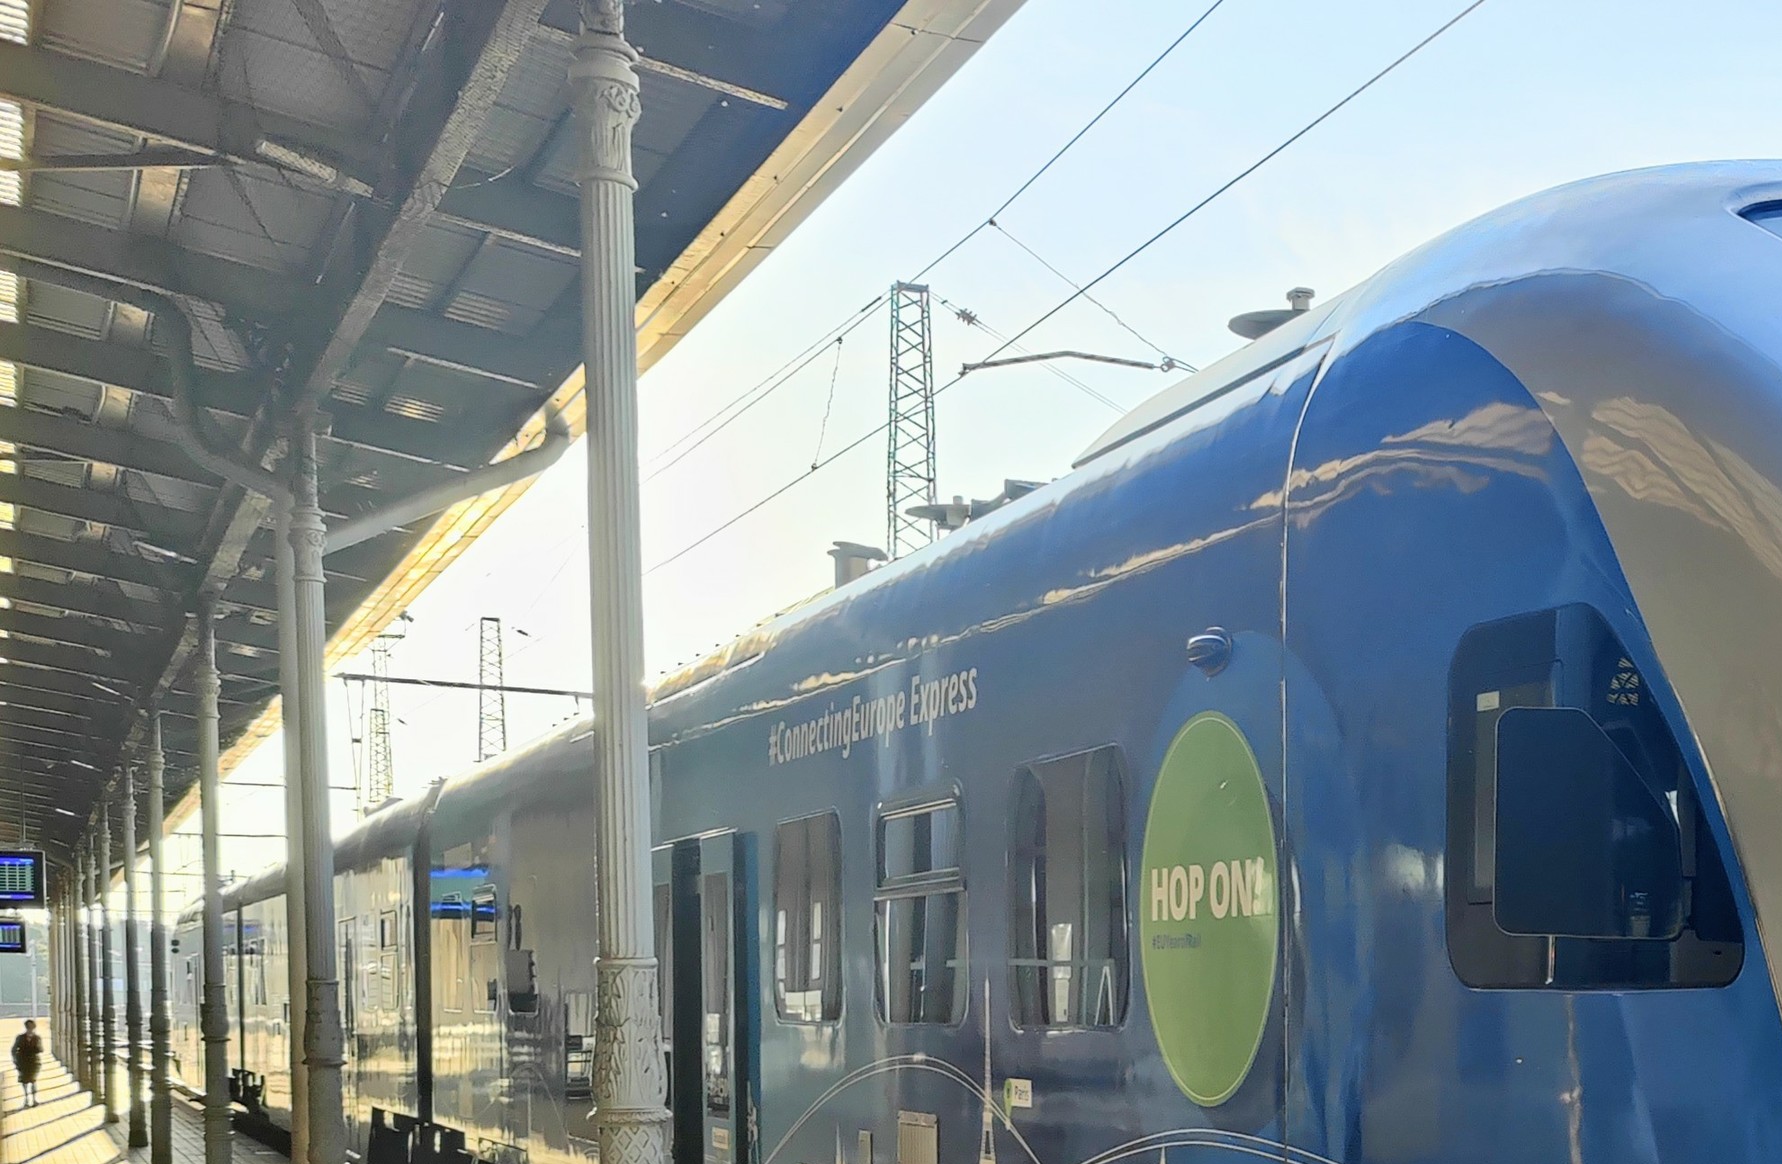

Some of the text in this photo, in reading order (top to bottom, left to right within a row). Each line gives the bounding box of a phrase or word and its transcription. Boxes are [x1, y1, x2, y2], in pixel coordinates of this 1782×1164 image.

[768, 667, 978, 767] #ConnectingEurope Express
[1150, 864, 1205, 922] HOP
